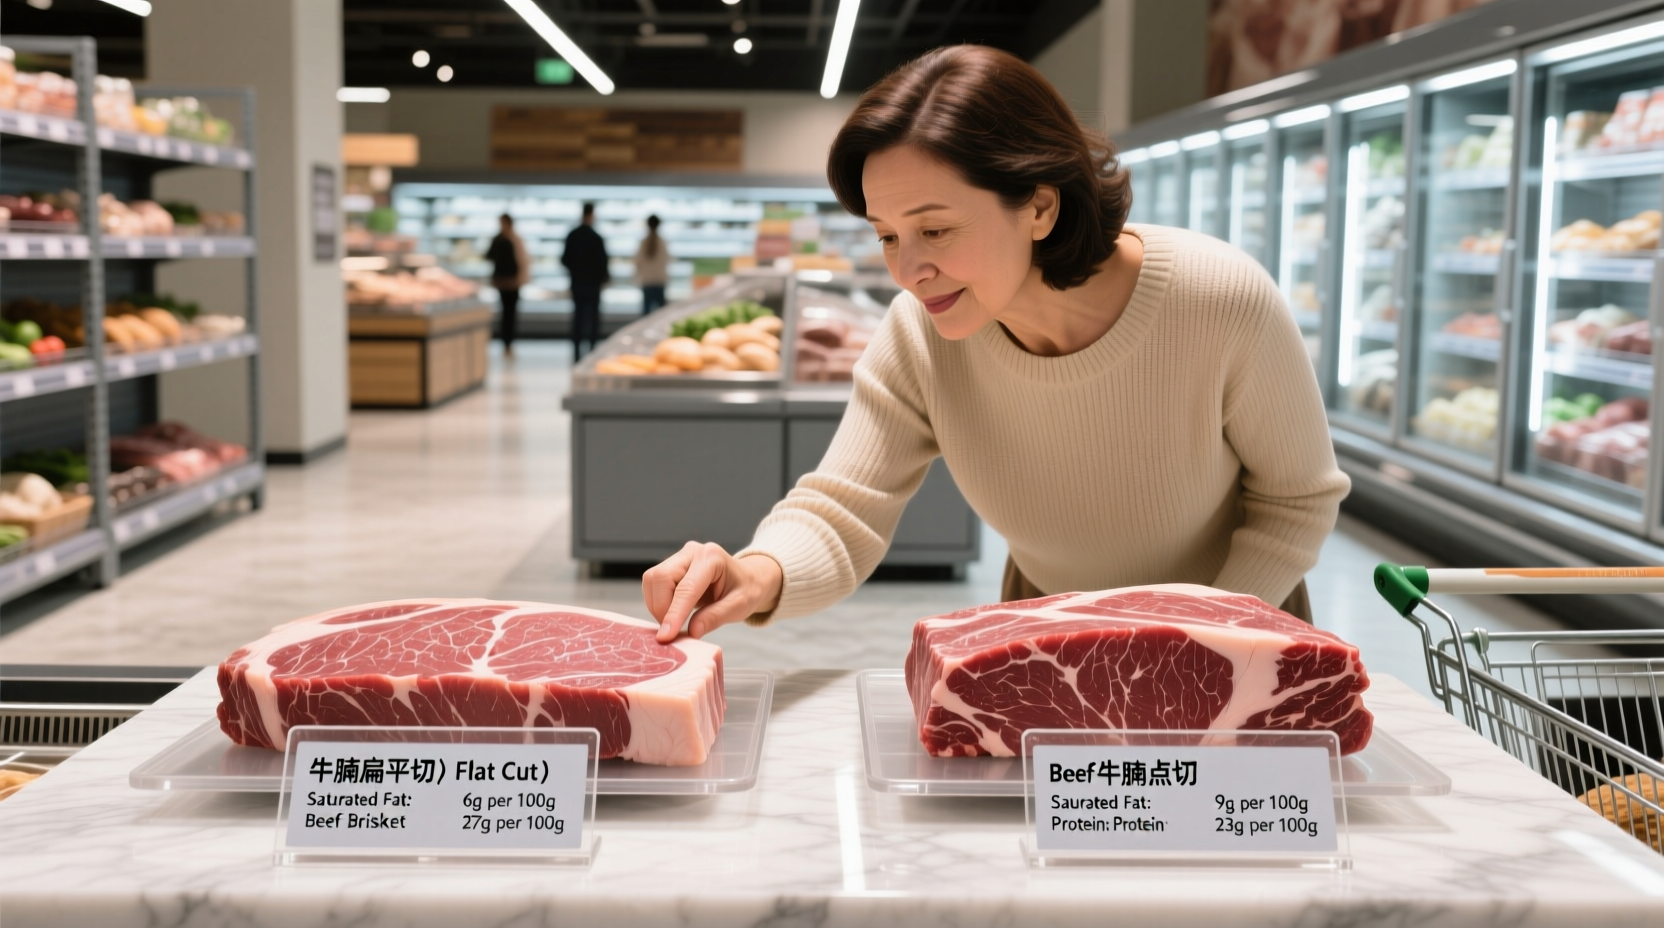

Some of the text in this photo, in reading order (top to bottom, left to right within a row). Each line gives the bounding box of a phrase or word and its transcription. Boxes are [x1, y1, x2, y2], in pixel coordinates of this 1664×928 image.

[455, 760, 496, 781] Flat
[501, 759, 549, 785] Cut)
[383, 791, 412, 807] Fat:
[462, 792, 556, 812] 6g per 100g
[1051, 794, 1151, 810] Saurated Fat:
[1214, 793, 1309, 815] 9g per 100g
[305, 812, 406, 829] Beef Brisket
[462, 814, 565, 835] 27g per 100g
[1051, 815, 1110, 832] Protein:
[1215, 817, 1318, 838] 23g per 100g
